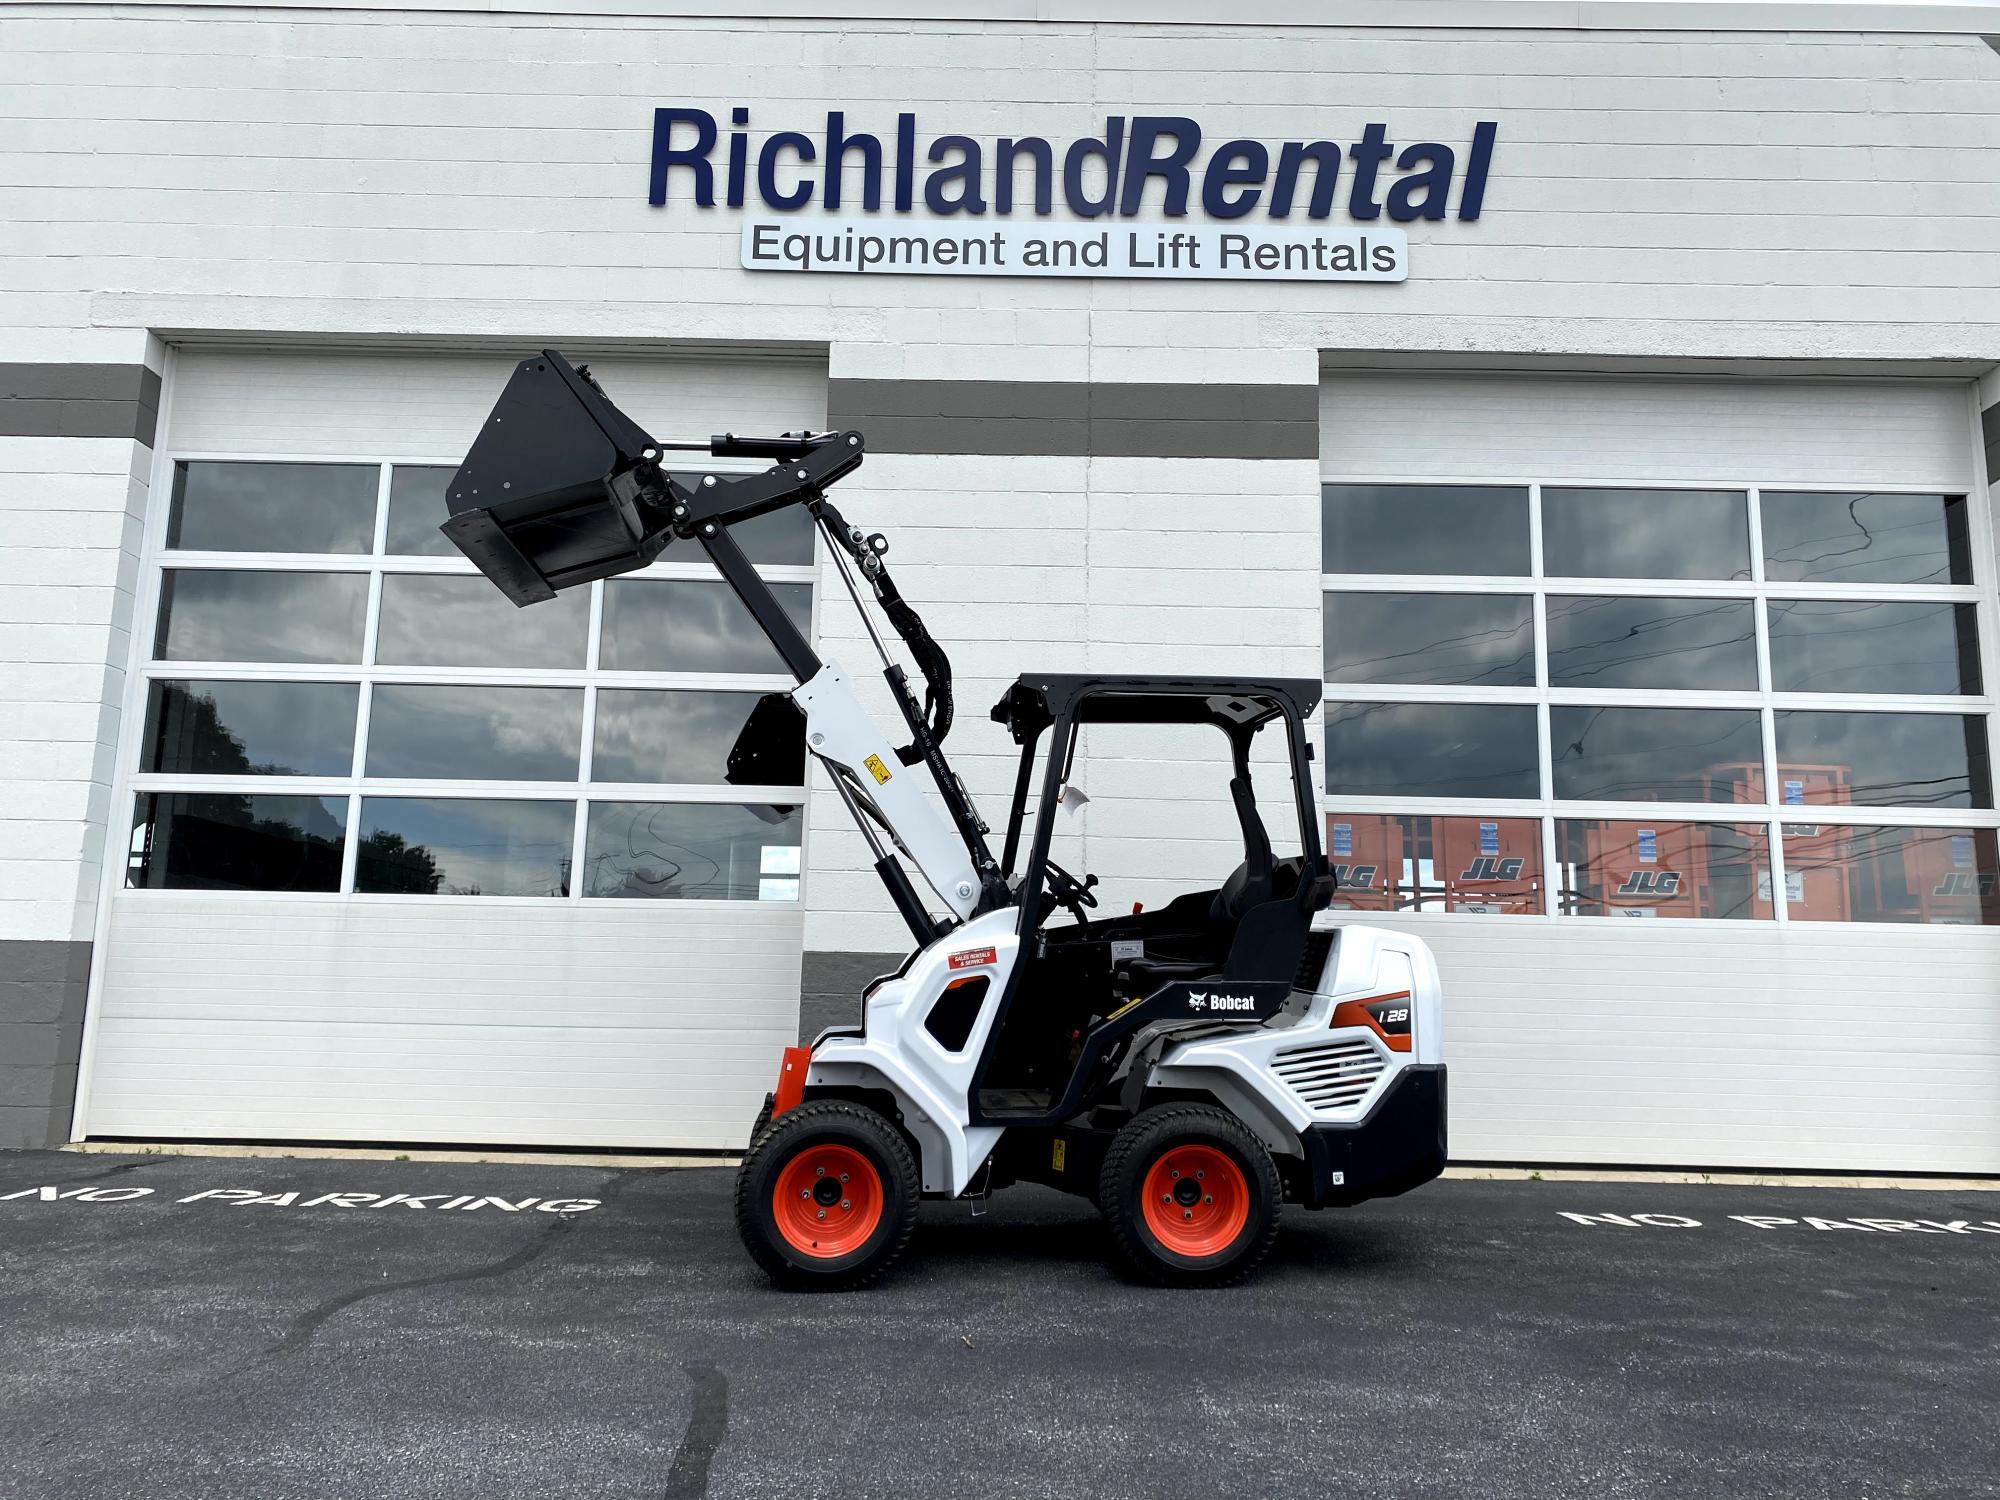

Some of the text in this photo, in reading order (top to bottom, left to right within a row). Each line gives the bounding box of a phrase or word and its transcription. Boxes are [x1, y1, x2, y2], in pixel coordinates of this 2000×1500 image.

[752, 225, 1396, 272] Equipment and Lift Rentals
[1460, 857, 1524, 881] JLG
[1618, 871, 1682, 895] JLG
[1933, 873, 1997, 897] JLG
[954, 952, 991, 962] SALES RENTALS
[965, 958, 985, 966] SERVICE
[1210, 994, 1255, 1010] Bobcat
[0, 1187, 601, 1213] NO PARKING
[1556, 1212, 1703, 1228] NO
